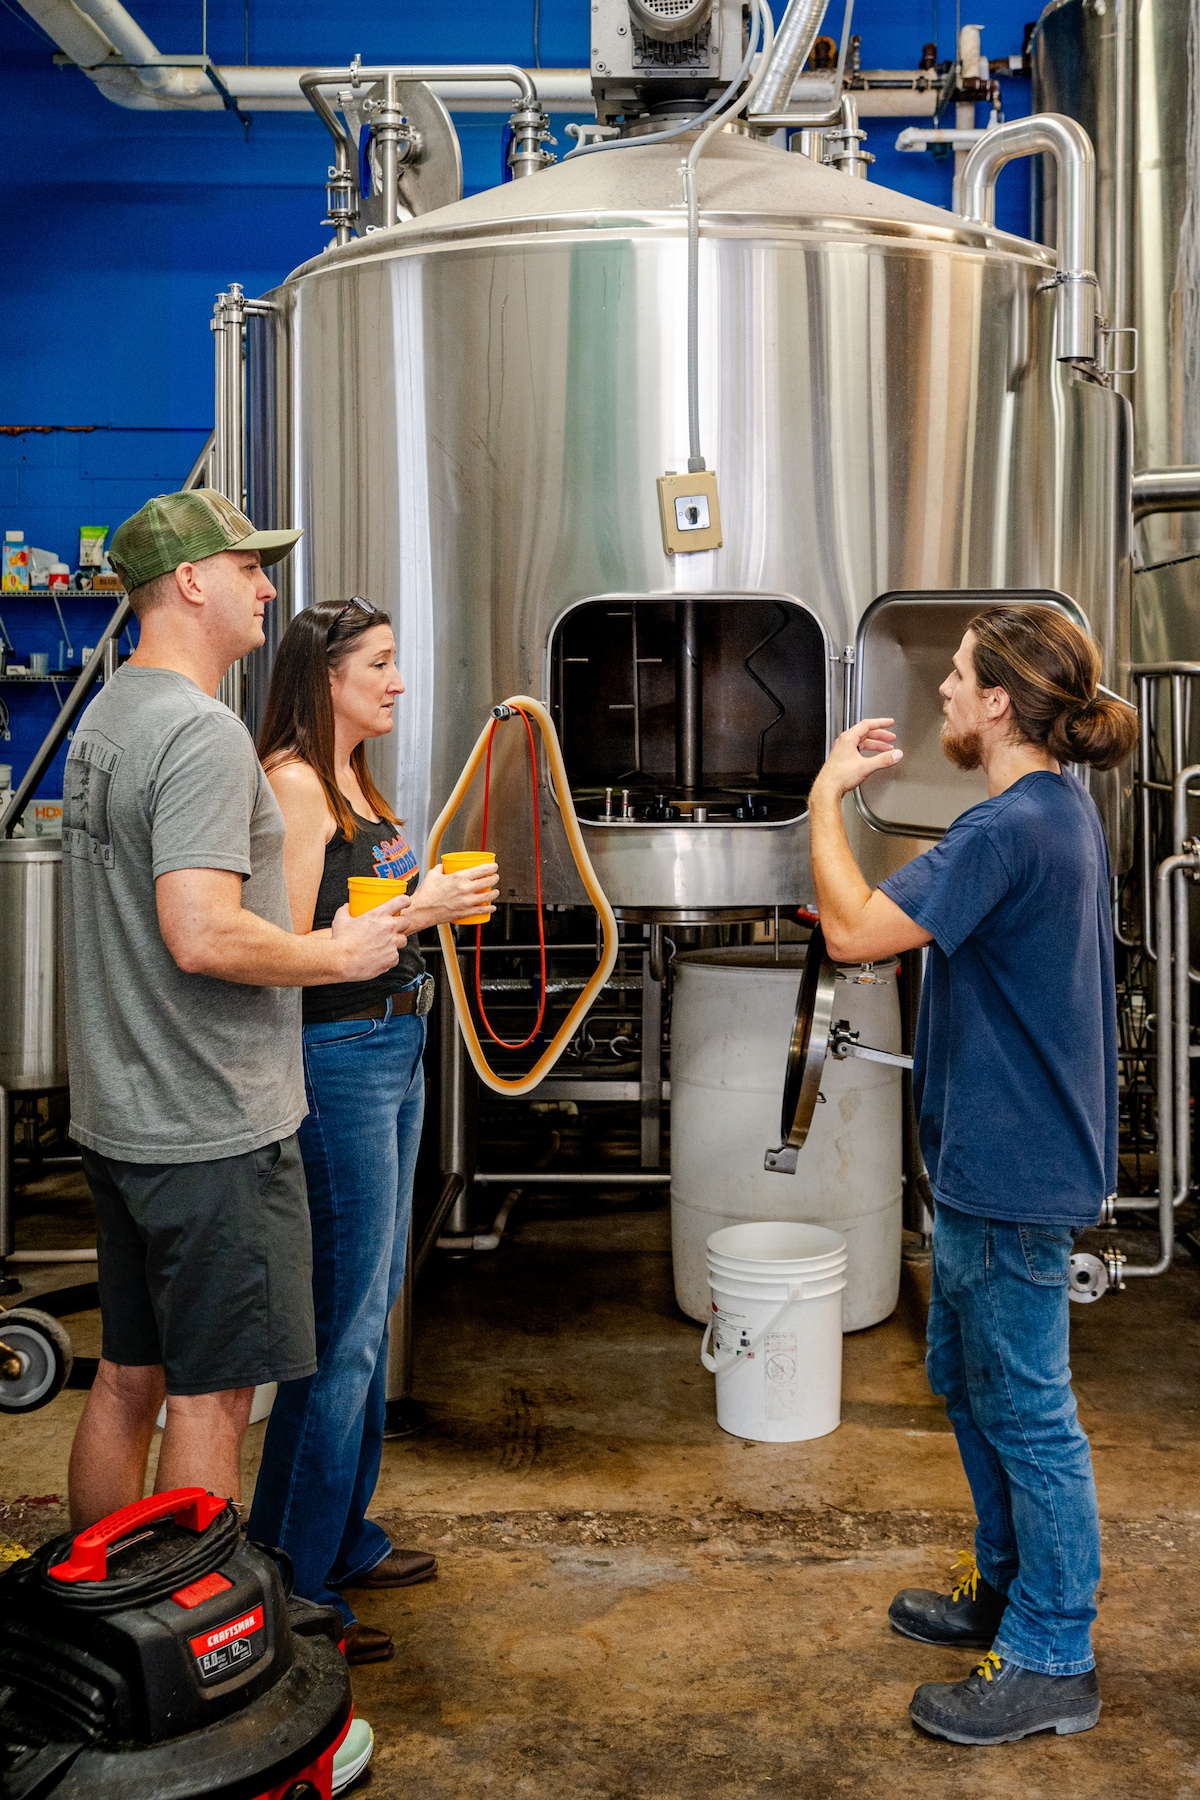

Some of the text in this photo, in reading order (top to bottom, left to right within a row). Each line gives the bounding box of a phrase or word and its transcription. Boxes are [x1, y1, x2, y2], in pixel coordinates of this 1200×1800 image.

[376, 850, 417, 879] FRIDAY
[207, 1615, 256, 1647] CRAFTSMAN
[203, 1652, 218, 1670] 6.0
[231, 1641, 240, 1657] 12
